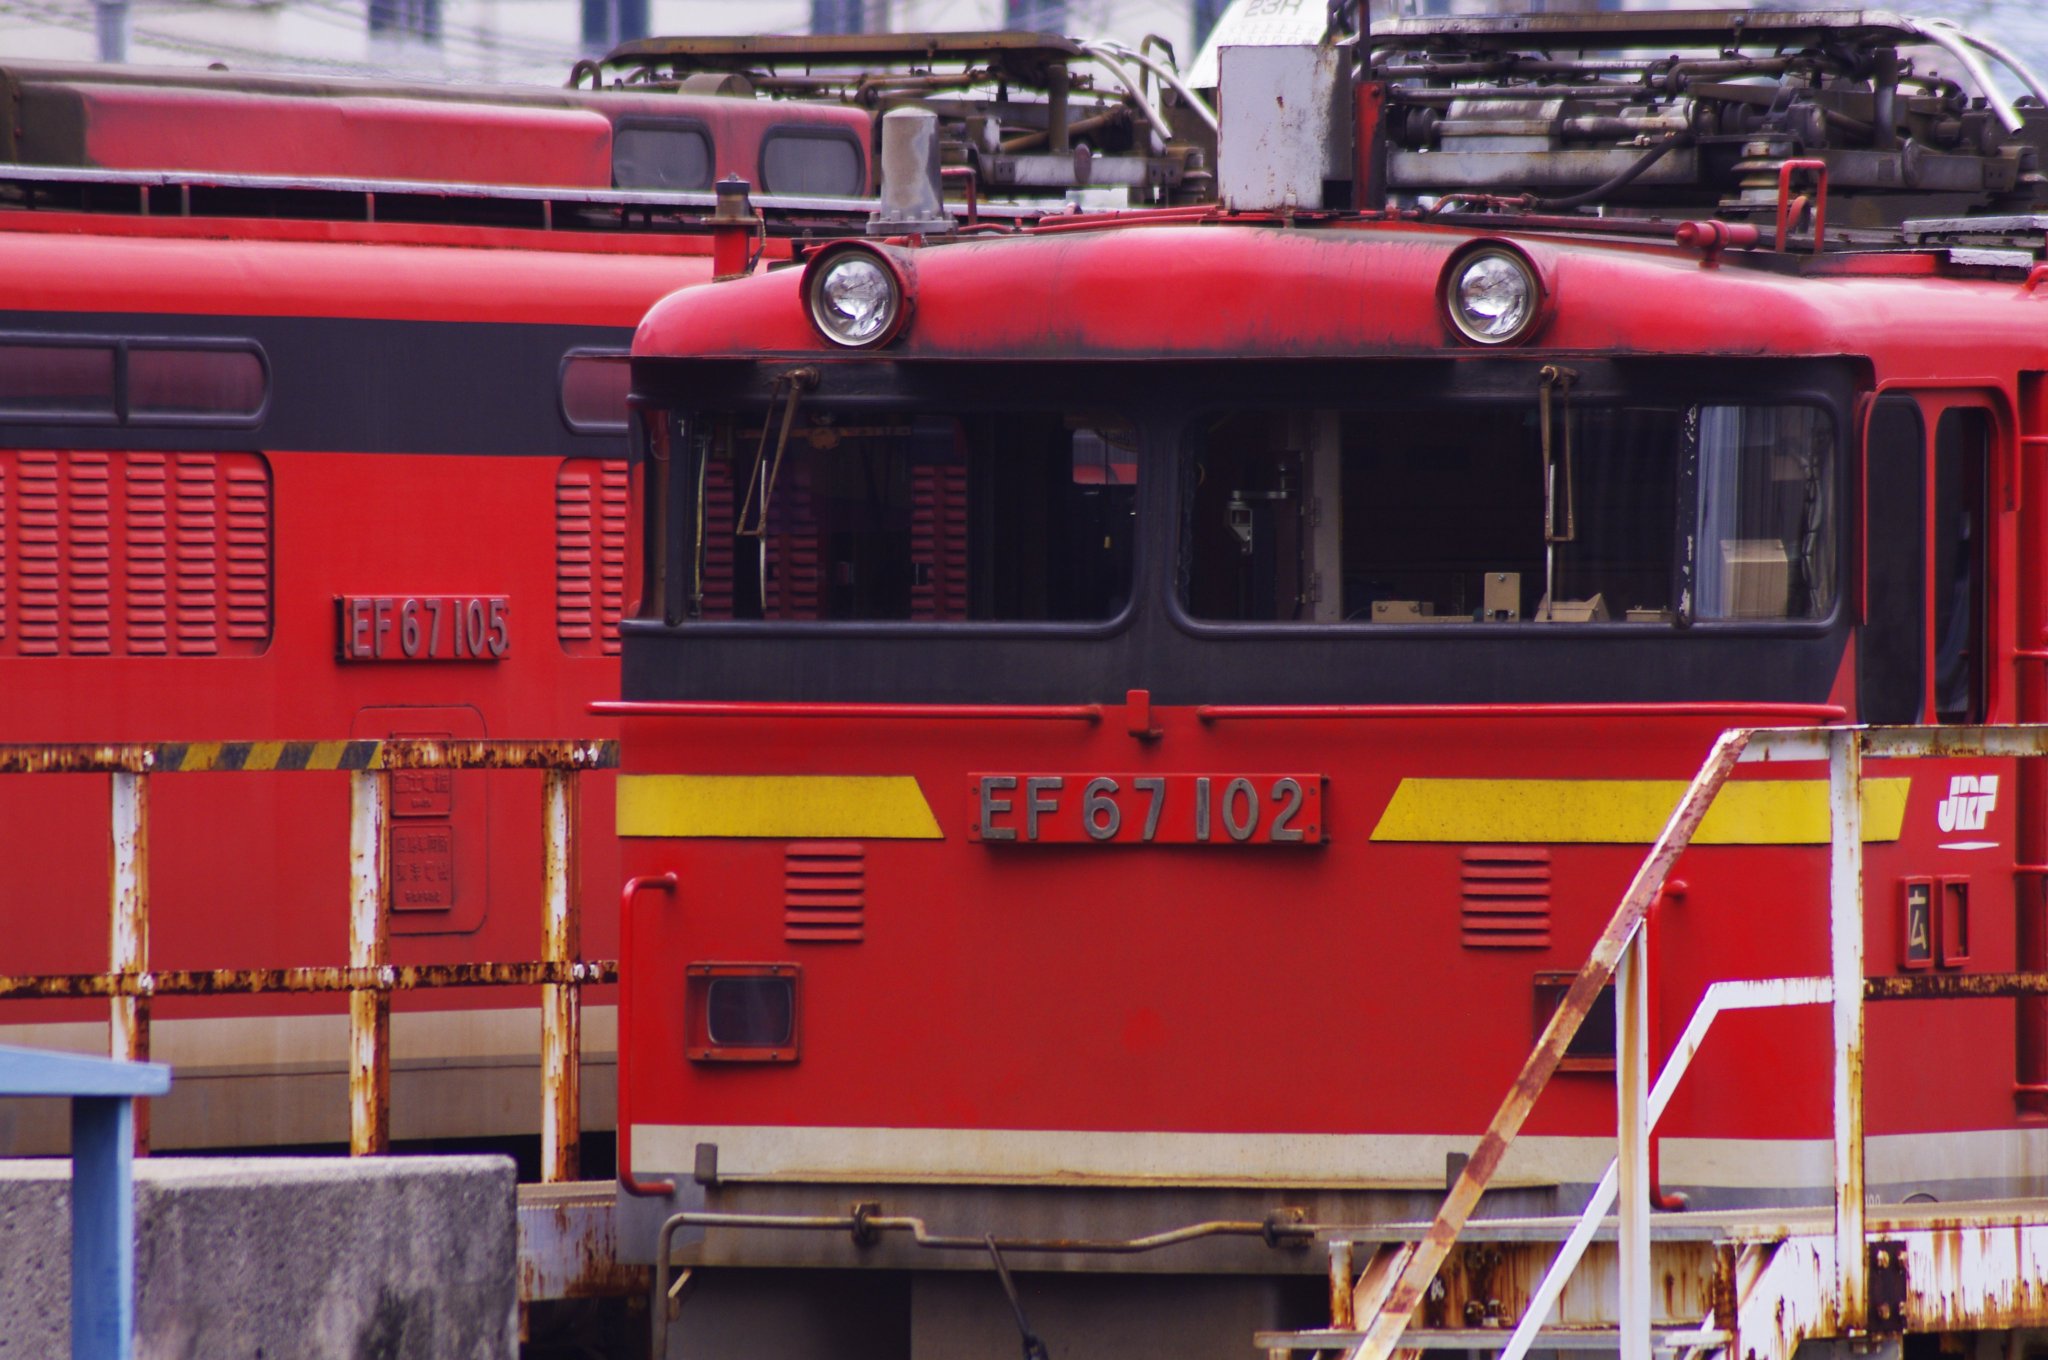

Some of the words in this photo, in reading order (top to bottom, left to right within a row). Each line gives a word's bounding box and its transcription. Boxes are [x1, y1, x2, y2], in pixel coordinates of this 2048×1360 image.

[352, 598, 394, 657] EF
[402, 598, 442, 657] 67
[454, 598, 508, 657] 105
[980, 776, 1063, 840] EF
[1083, 776, 1165, 840] 67
[1196, 776, 1304, 841] 102
[1908, 889, 1927, 950] 広
